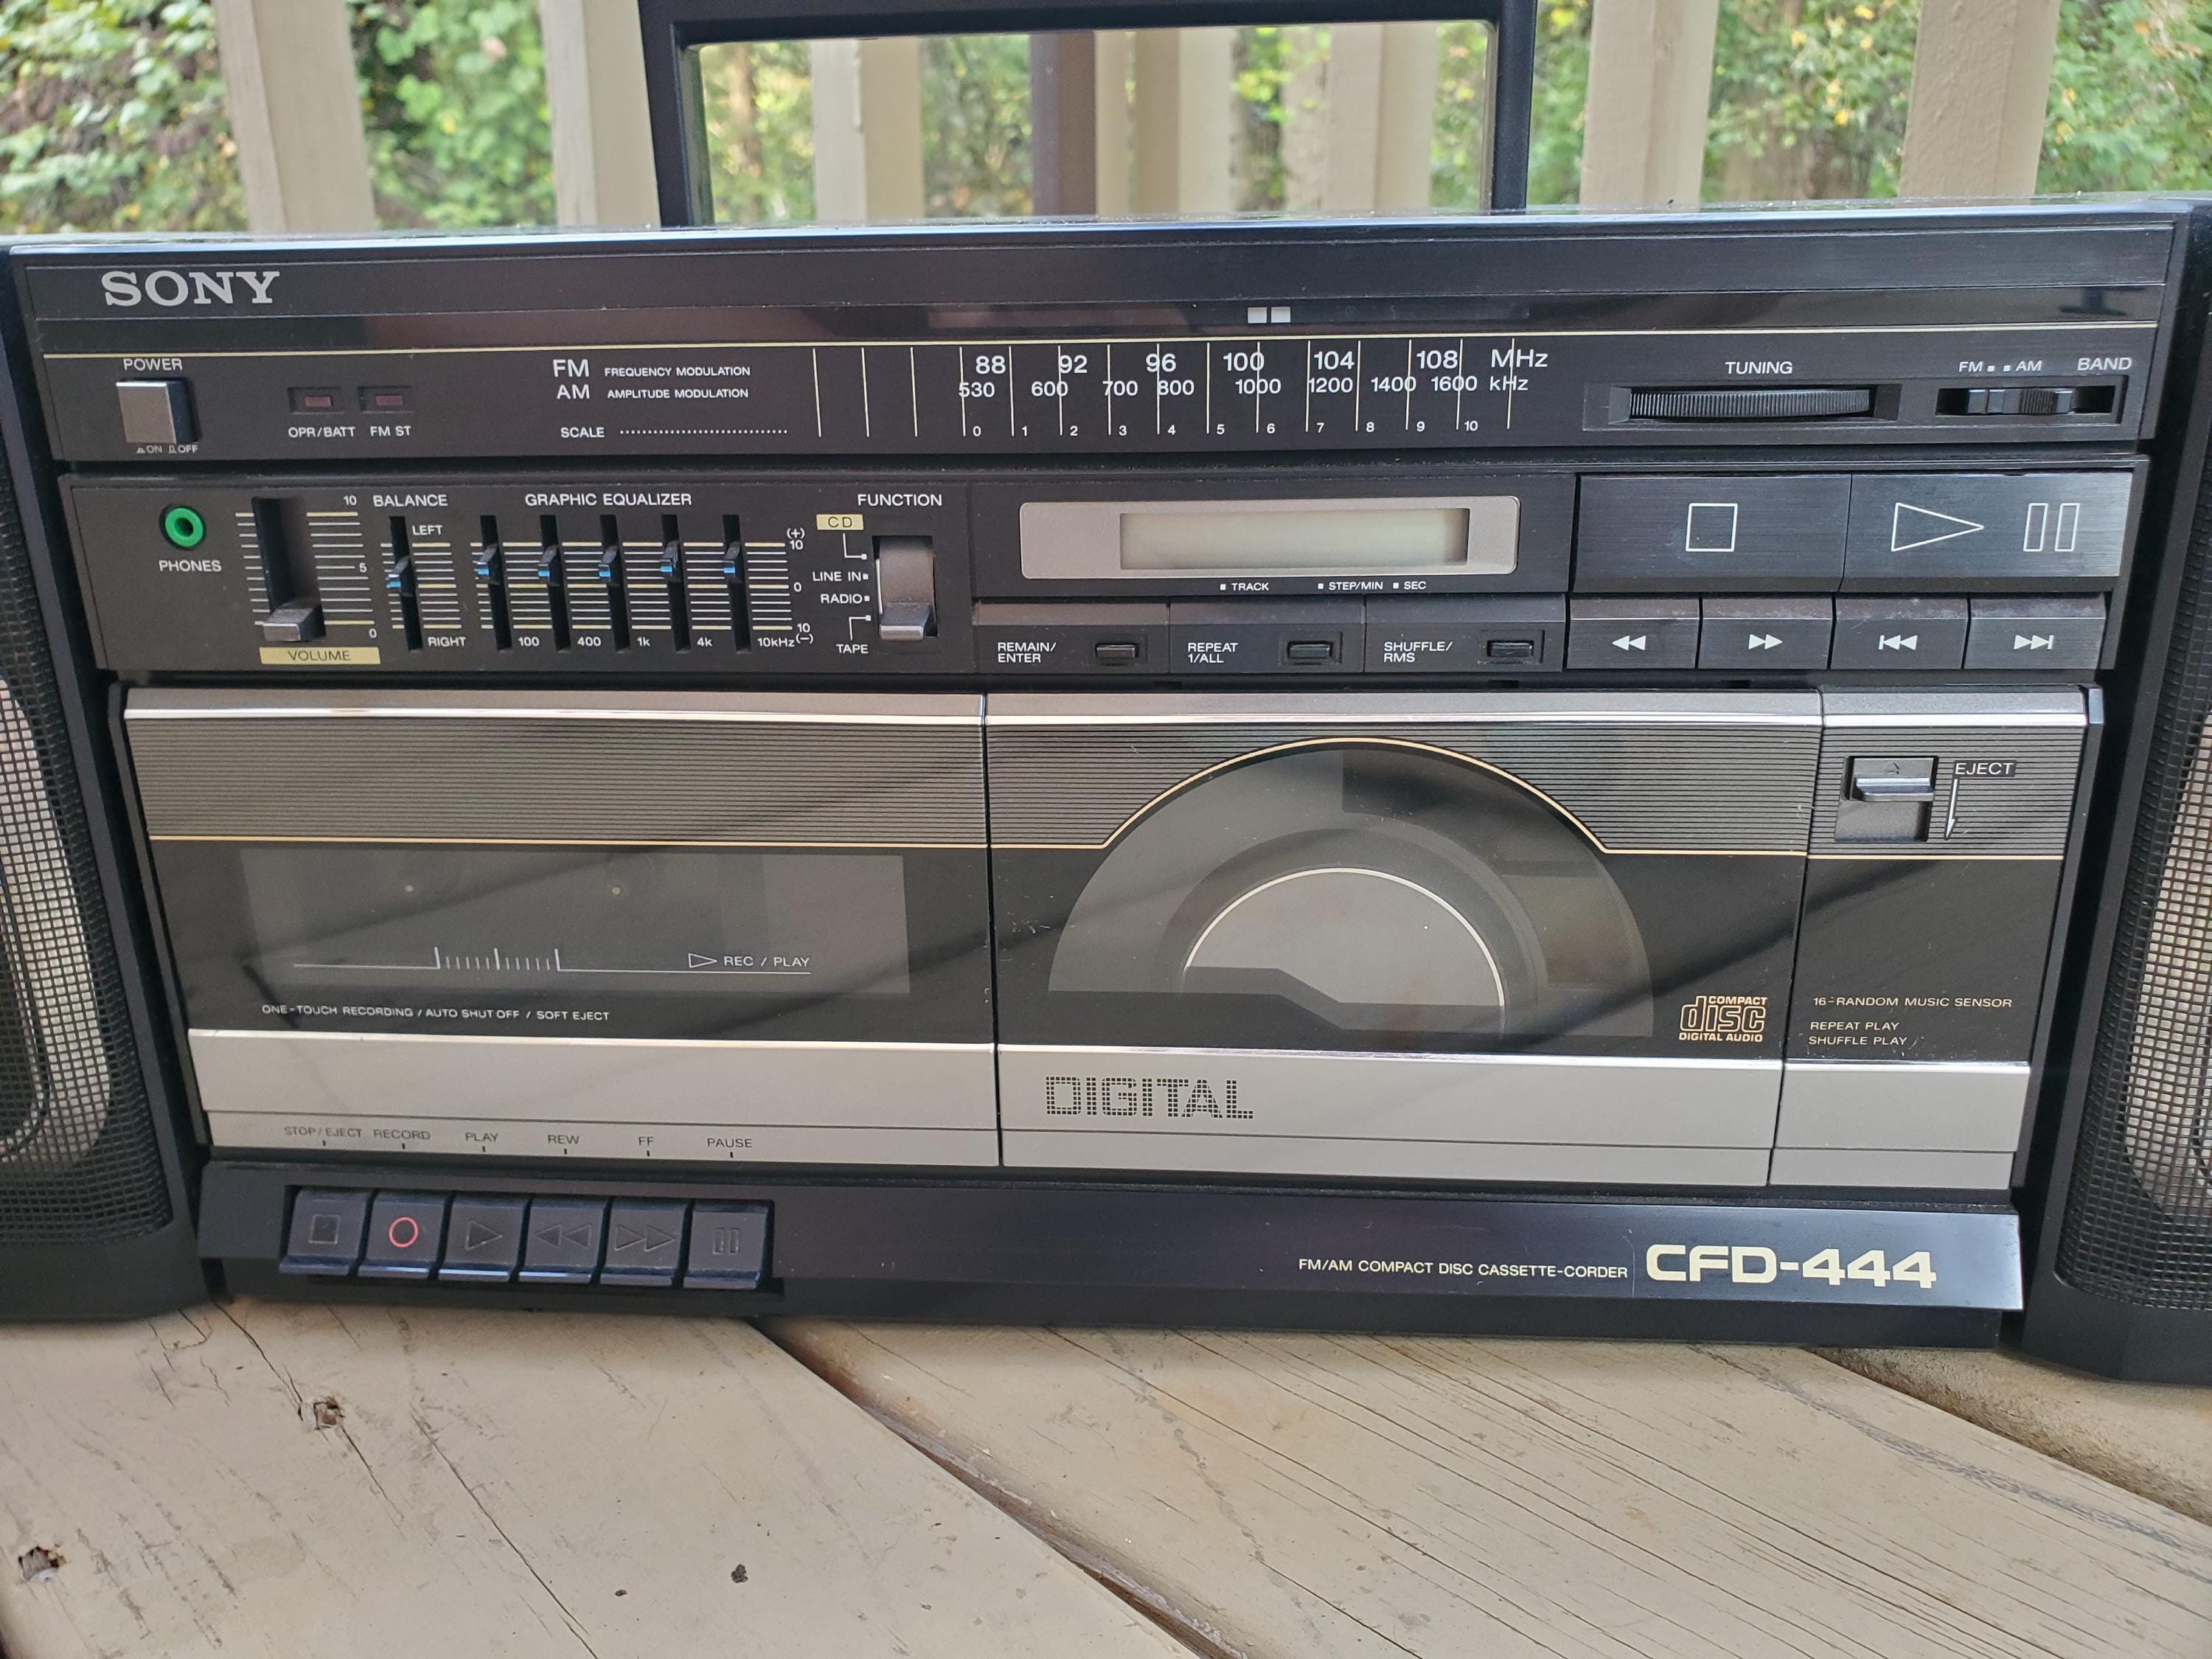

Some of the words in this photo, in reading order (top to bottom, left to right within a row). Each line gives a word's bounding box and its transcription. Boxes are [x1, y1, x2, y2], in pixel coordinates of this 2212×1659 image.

[101, 270, 280, 305] SONY
[123, 358, 183, 371] POWER
[975, 355, 1006, 374] 88
[1060, 355, 1088, 374] 92
[1146, 353, 1176, 372] 96
[1223, 352, 1265, 372] 100
[1314, 351, 1354, 369] 104
[1416, 350, 1458, 369] 108
[1491, 349, 1548, 367] MHz
[1958, 361, 1983, 372] FM
[2015, 361, 2042, 372] AM
[2077, 358, 2132, 371] BAND
[552, 358, 589, 378] FM
[605, 367, 671, 378] FREQUENCY
[676, 366, 751, 376] MODULATION
[1725, 361, 1792, 375] TUNING
[959, 382, 995, 397] 530
[1032, 381, 1068, 397] 600
[1102, 380, 1138, 396] 700
[1158, 380, 1194, 395] 800
[1235, 379, 1281, 394] 1000
[1309, 378, 1353, 393] 1200
[1371, 377, 1416, 392] 1400
[1431, 376, 1478, 392] 1600
[1489, 375, 1528, 391] kHz
[557, 385, 590, 400] AM
[607, 389, 670, 399] AMPLITUDE
[675, 389, 748, 398] MODULATION
[288, 426, 355, 438] OPR/BATT
[370, 426, 390, 437] FM
[396, 425, 411, 436] ST
[560, 427, 605, 438] SCALE
[973, 426, 981, 437] 0
[1022, 426, 1028, 437] 1
[1070, 426, 1078, 437] 2
[1119, 425, 1127, 436] 3
[1167, 425, 1176, 435] 4
[1217, 425, 1225, 435] 5
[1267, 423, 1276, 434] 6
[1316, 422, 1324, 433] 7
[1366, 422, 1374, 432] 8
[1416, 421, 1425, 431] 9
[1464, 421, 1478, 431] 10
[147, 445, 162, 453] ON
[178, 445, 198, 453] OFF
[344, 495, 357, 506] 10
[373, 495, 448, 507] BALANCE
[525, 494, 597, 506] GRAPHIC
[603, 493, 692, 506] EQUALIZER
[858, 494, 942, 506] FUNCTION
[412, 525, 442, 535] LEFT
[790, 540, 804, 550] 10
[159, 560, 221, 572] PHONES
[359, 563, 366, 573] 5
[812, 571, 842, 582] LINE
[848, 571, 861, 582] IN
[793, 583, 802, 592] 0
[1231, 582, 1269, 591] TRACK
[1329, 581, 1383, 591] STEP/MIN
[1404, 581, 1427, 591] SEC
[821, 594, 863, 604] RADIO
[796, 622, 810, 633] 10
[369, 628, 377, 639] 0
[428, 636, 466, 647] RIGHT
[518, 637, 540, 647] 100
[577, 637, 602, 647] 400
[637, 637, 650, 647] 1k
[697, 637, 712, 647] 4k
[1384, 641, 1452, 653] SHUFFLE/
[836, 644, 869, 654] TAPE
[998, 642, 1056, 653] REMAIN/
[1187, 642, 1238, 653] REPEAT
[288, 650, 351, 661] VOLUME
[998, 653, 1040, 664] ENTER
[1188, 653, 1224, 664] 1/ALL
[1384, 653, 1416, 663] RMS
[1955, 762, 2014, 775] EJECT
[724, 956, 754, 966] REC
[773, 957, 810, 967] PLAY
[1708, 996, 1767, 1005] COMPACT
[1905, 998, 1949, 1006] MUSIC
[1954, 998, 2011, 1007] SENSOR
[262, 1004, 337, 1015] ONE-TOUCH
[342, 1006, 413, 1017] RECORDING
[425, 1009, 458, 1018] AUTO
[462, 1009, 493, 1018] SHUT
[496, 1010, 519, 1019] OFF
[537, 1011, 568, 1020] SOFT
[573, 1012, 610, 1020] EJECT
[1810, 1022, 1860, 1030] REPEAT
[1865, 1022, 1899, 1030] PLAY
[1679, 1032, 1722, 1041] DIGITAL
[1726, 1034, 1763, 1042] AUDIO
[1809, 1036, 1868, 1045] SHUFFLE
[1874, 1037, 1907, 1045] PLAY
[1046, 1077, 1253, 1119] DIGITAL
[374, 1129, 430, 1140] RECORD
[465, 1132, 498, 1142] PLAY
[548, 1135, 580, 1144] REW
[639, 1136, 654, 1145] FF
[707, 1138, 753, 1147] PAUSE
[1299, 1258, 1353, 1271] FM/AM
[1357, 1260, 1433, 1273] COMPACT
[1439, 1262, 1473, 1275] DISC
[1478, 1263, 1628, 1279] CASSETTE-CORDER
[1646, 1245, 1936, 1288] CFD-444
